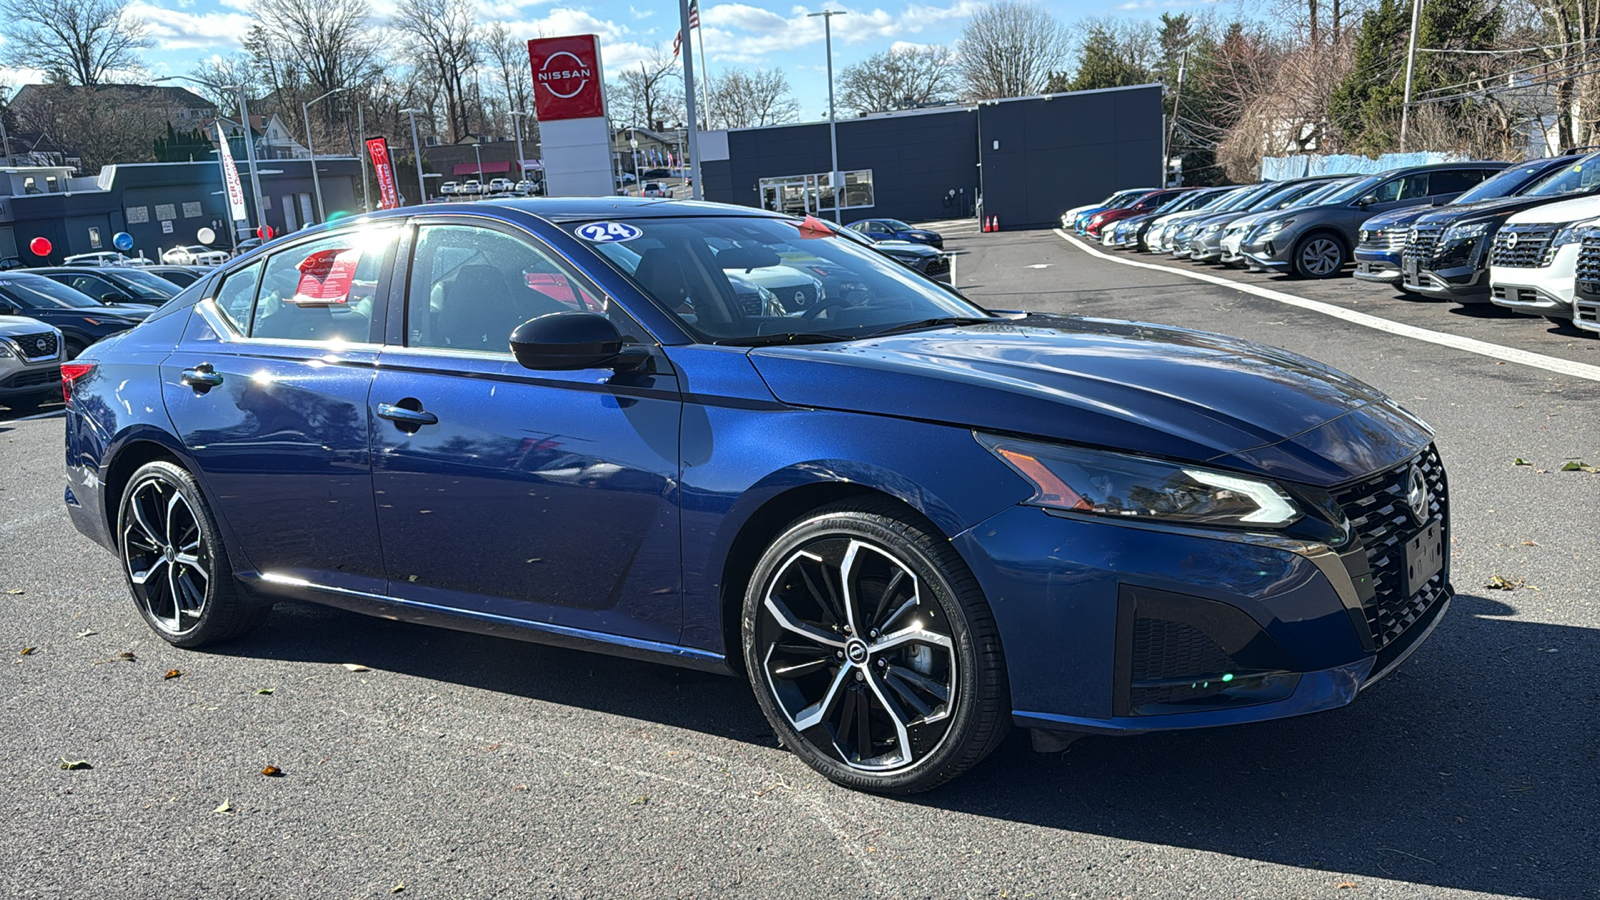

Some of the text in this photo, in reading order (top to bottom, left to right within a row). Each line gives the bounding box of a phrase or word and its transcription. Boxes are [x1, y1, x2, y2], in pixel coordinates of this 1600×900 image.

[538, 68, 591, 81] NISSAN
[585, 222, 632, 241] 24
[821, 519, 901, 546] BRIDGESTONE
[808, 753, 884, 789] BRIDGESTONE
